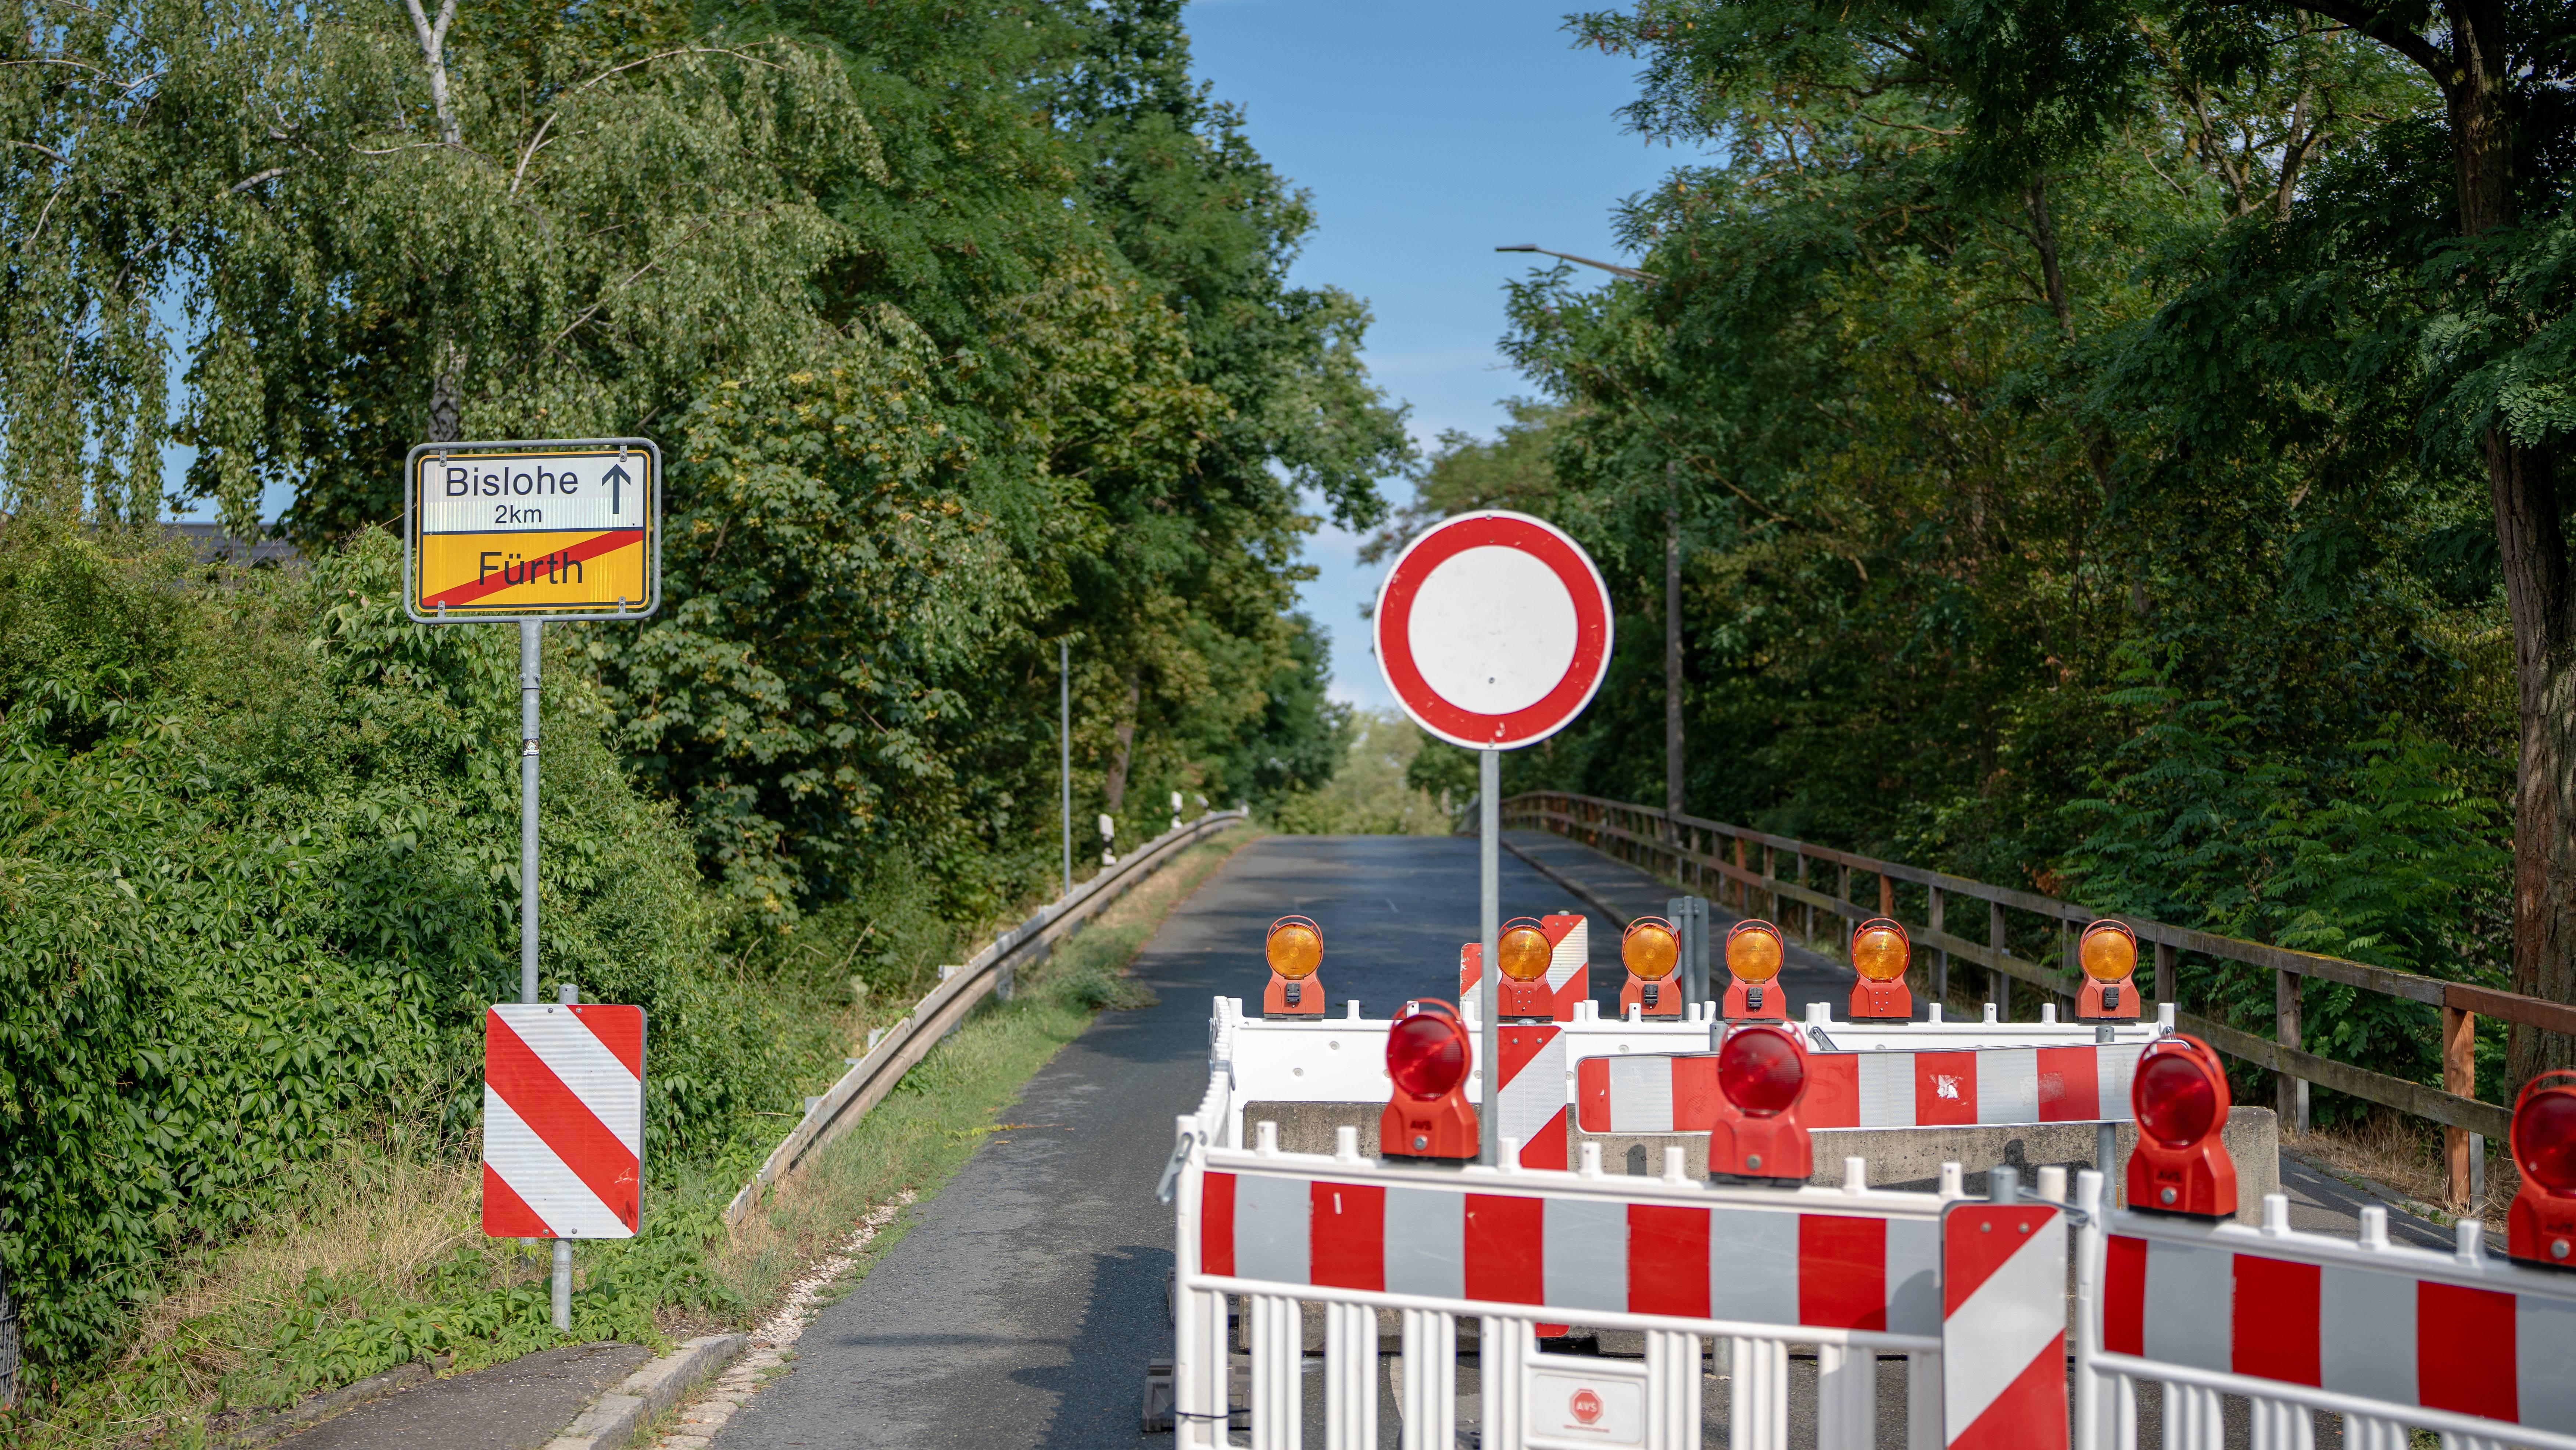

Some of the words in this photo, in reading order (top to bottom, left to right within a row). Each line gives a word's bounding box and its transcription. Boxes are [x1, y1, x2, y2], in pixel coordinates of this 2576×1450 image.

[446, 465, 578, 497] Bislohe
[495, 504, 542, 524] 2km
[479, 551, 583, 585] Fürth
